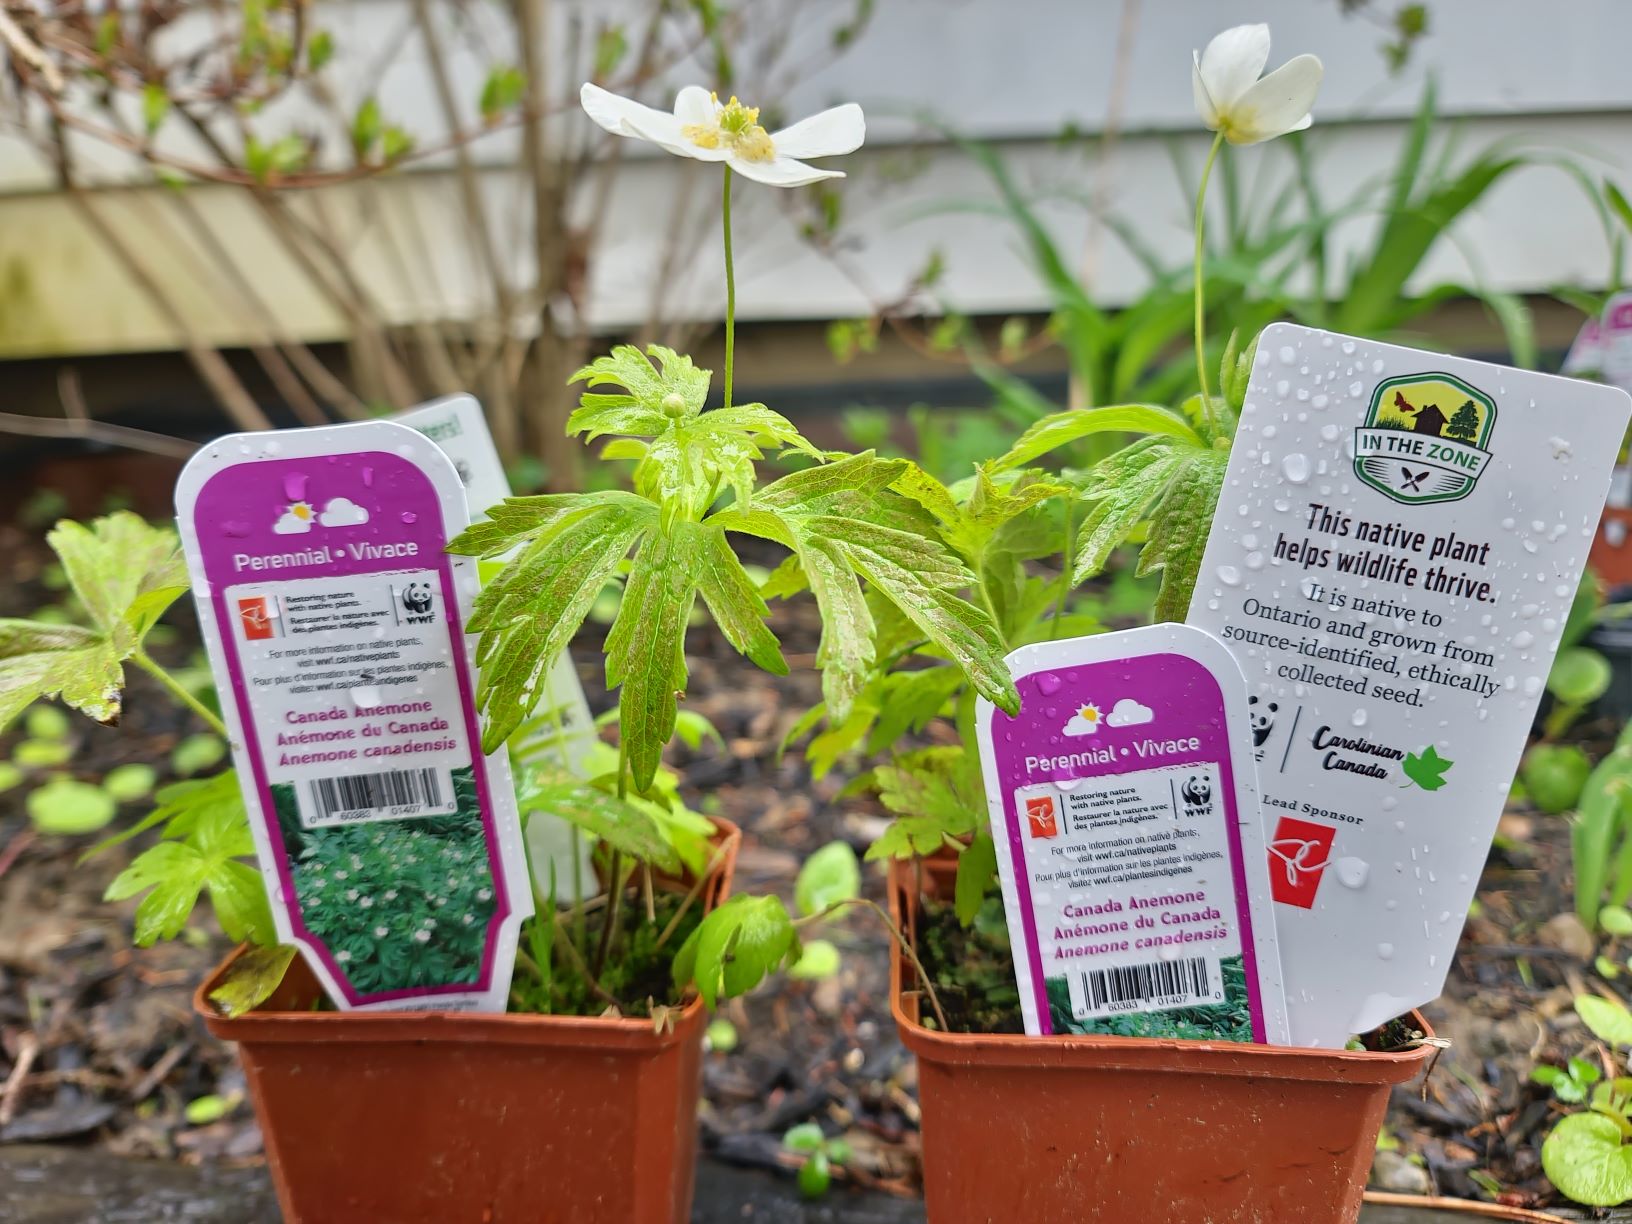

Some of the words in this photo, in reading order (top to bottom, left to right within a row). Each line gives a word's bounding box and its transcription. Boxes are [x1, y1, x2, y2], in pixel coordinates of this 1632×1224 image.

[1362, 434, 1382, 450] IN
[1387, 436, 1424, 455] THE
[1426, 443, 1481, 471] ZONE
[1307, 503, 1351, 536] This
[1355, 520, 1425, 552] native
[1430, 532, 1490, 566] plant
[233, 546, 333, 572] Perennial
[349, 542, 418, 560] Vivace
[1273, 532, 1331, 569] helps
[1337, 550, 1418, 587] wildlife
[1424, 566, 1497, 603] thrive.
[406, 614, 435, 625] WWF
[1306, 583, 1326, 603] It
[1328, 588, 1347, 607] is
[1352, 595, 1416, 622] native
[1422, 608, 1442, 628] to
[1242, 598, 1321, 629] Ontario
[1326, 617, 1366, 640] and
[1368, 629, 1436, 655] grown
[1443, 640, 1495, 667] from
[269, 650, 282, 659] For
[285, 648, 307, 657] more
[308, 643, 355, 655] information
[357, 642, 367, 650] on
[369, 639, 393, 649] native
[1222, 623, 1401, 679] source-identified,
[1408, 664, 1501, 699] ethically
[1278, 663, 1369, 695] collected
[1371, 684, 1425, 708] seed.
[286, 706, 348, 724] Canada
[355, 701, 432, 718] Anemone
[277, 727, 356, 746] Anémone
[362, 723, 382, 737] du
[388, 717, 449, 735] Canada
[1312, 726, 1405, 760] Carolinian
[279, 749, 358, 766] Anemone
[364, 736, 457, 758] canadensis
[1024, 746, 1117, 774] Perennial
[1132, 737, 1200, 759] Vivace
[1323, 751, 1389, 780] Canada
[1069, 790, 1108, 801] Restoring
[1109, 787, 1136, 797] nature
[1071, 801, 1089, 810] with
[1090, 799, 1115, 808] native
[1117, 795, 1142, 805] plants.
[1073, 811, 1112, 822] Restaurer
[1113, 808, 1120, 816] la
[1122, 806, 1149, 815] nature
[1150, 803, 1169, 811] avec
[1074, 821, 1088, 830] des
[1090, 818, 1118, 830] plantes
[1184, 807, 1213, 817] WWF
[1262, 794, 1297, 811] Lead
[1301, 803, 1364, 826] Sponsor
[1051, 846, 1064, 856] For
[1066, 844, 1087, 854] more
[1088, 837, 1133, 851] information
[1135, 835, 1145, 844] on
[1147, 832, 1171, 842] native
[1077, 854, 1093, 863] visit
[1095, 842, 1177, 861] wwf.ca/nativeplants
[1035, 873, 1052, 882] Pour
[1055, 870, 1072, 882] plus
[1073, 863, 1124, 877] d'information
[1125, 861, 1139, 869] sur
[1140, 858, 1151, 867] les
[1153, 855, 1182, 868] plantes
[1068, 878, 1092, 889] visitez
[1094, 865, 1193, 886] wwf.ca/plantesindigenes
[1063, 899, 1122, 919] Canada
[1128, 890, 1205, 910] Anemone
[1053, 919, 1128, 940] Anémone
[1134, 914, 1155, 929] du
[1160, 906, 1221, 926] Canada
[1054, 940, 1129, 960] Anemone
[1135, 925, 1227, 950] canadensis
[1078, 1008, 1085, 1016] 0
[1157, 994, 1188, 1006] 01407
[1214, 991, 1221, 999] 0
